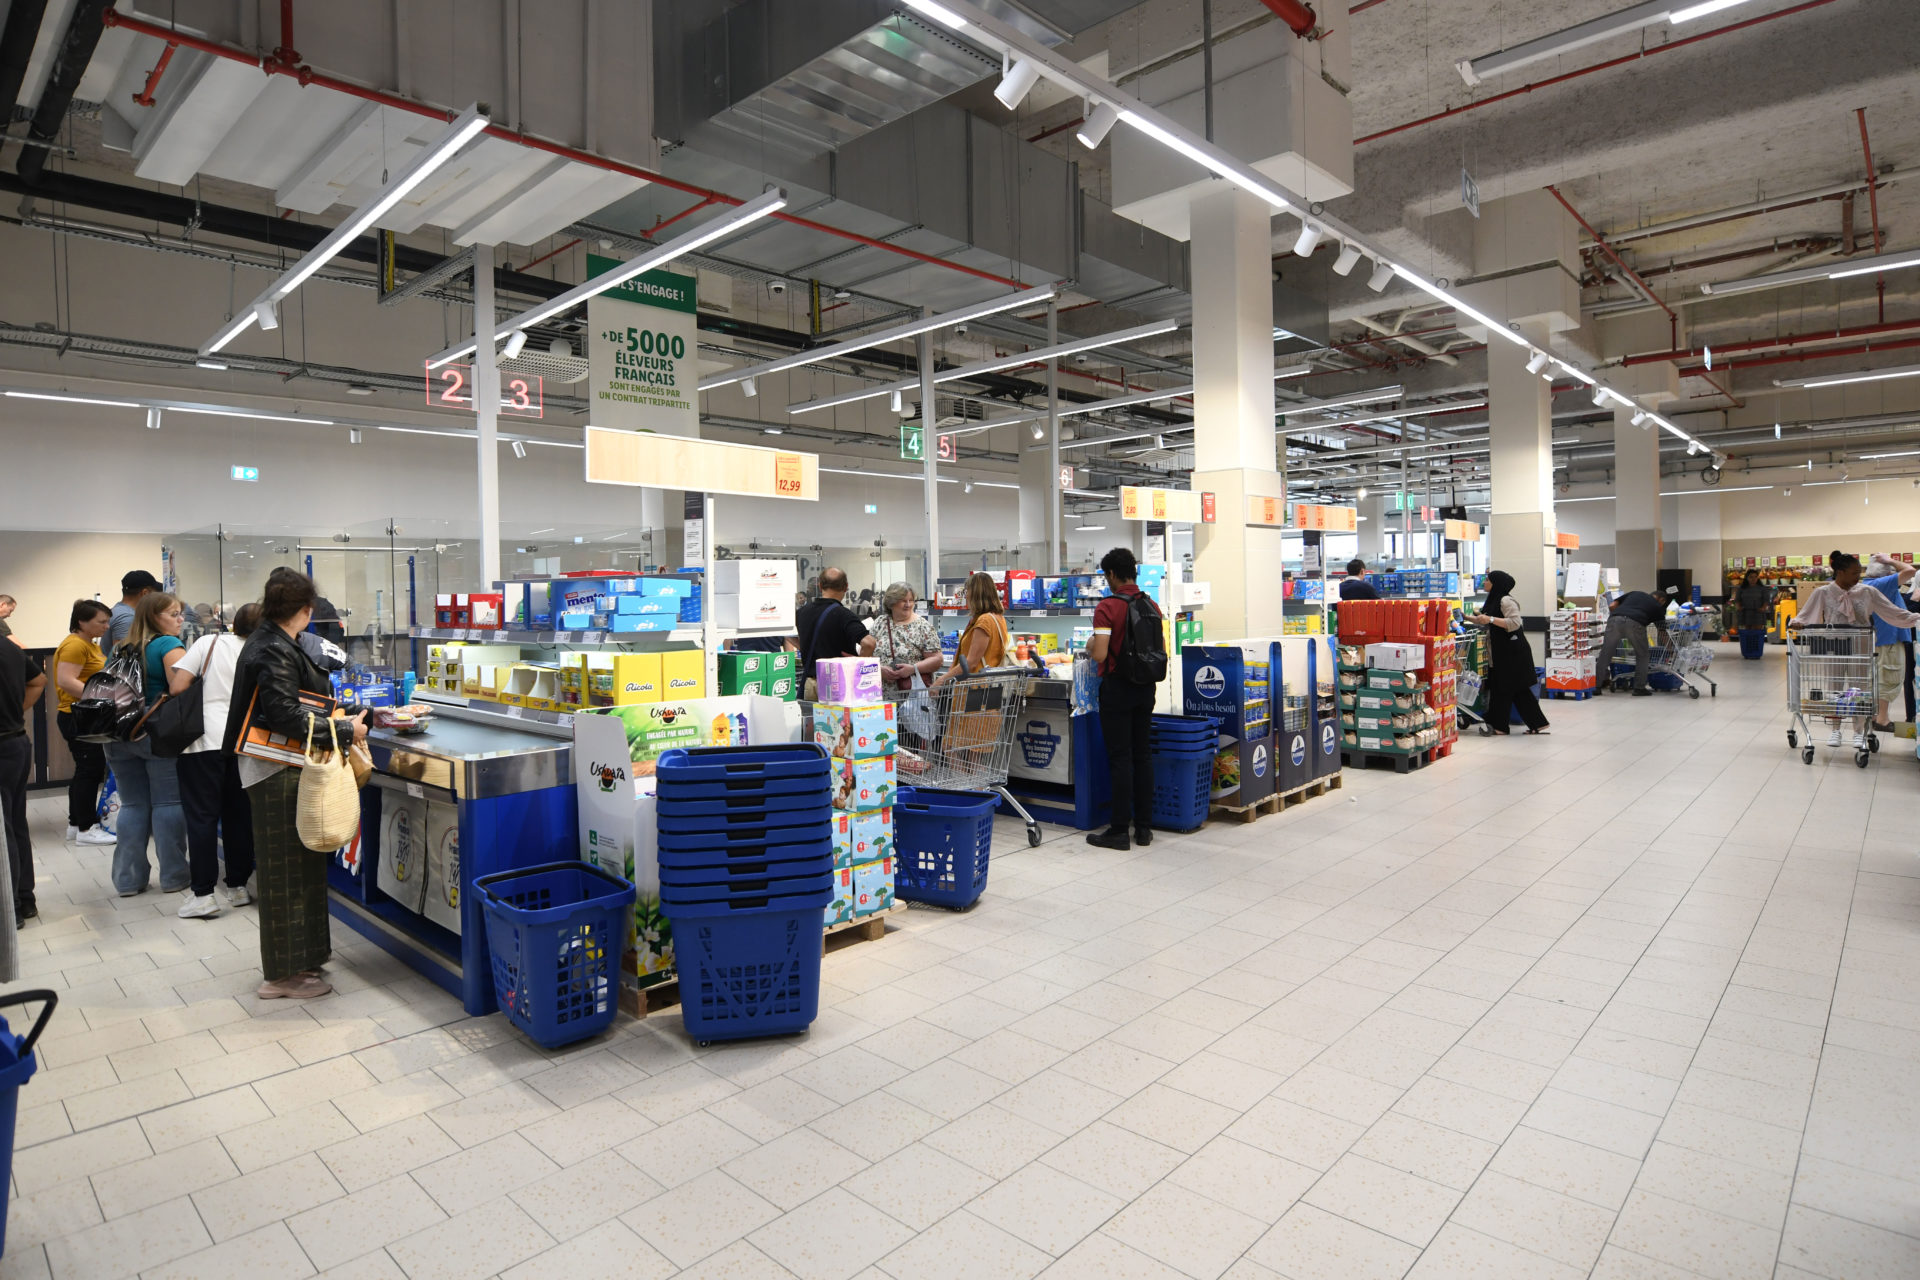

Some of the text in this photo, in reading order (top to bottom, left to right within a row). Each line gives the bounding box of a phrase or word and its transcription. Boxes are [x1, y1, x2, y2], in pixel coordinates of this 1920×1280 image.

[628, 280, 679, 300] S'ENGAGE
[609, 330, 623, 344] DE
[626, 327, 685, 359] 5000
[615, 349, 674, 372] ÉLEVEURS
[441, 369, 464, 402] 2
[615, 366, 675, 386] FRANÇAIS
[509, 379, 530, 410] 3
[609, 381, 630, 392] SONT
[666, 388, 681, 398] PAR
[599, 391, 691, 410] UN CONTRAT TRIPARTITE
[908, 433, 919, 455] 4
[939, 435, 950, 458] 5
[625, 682, 653, 692] Ricola
[671, 679, 697, 688] Ricola
[650, 706, 687, 718] Ushuaïa
[1186, 698, 1197, 711] On
[1215, 700, 1236, 713] besoin
[1028, 751, 1049, 760] choses
[590, 761, 626, 782] Ushuaïa
